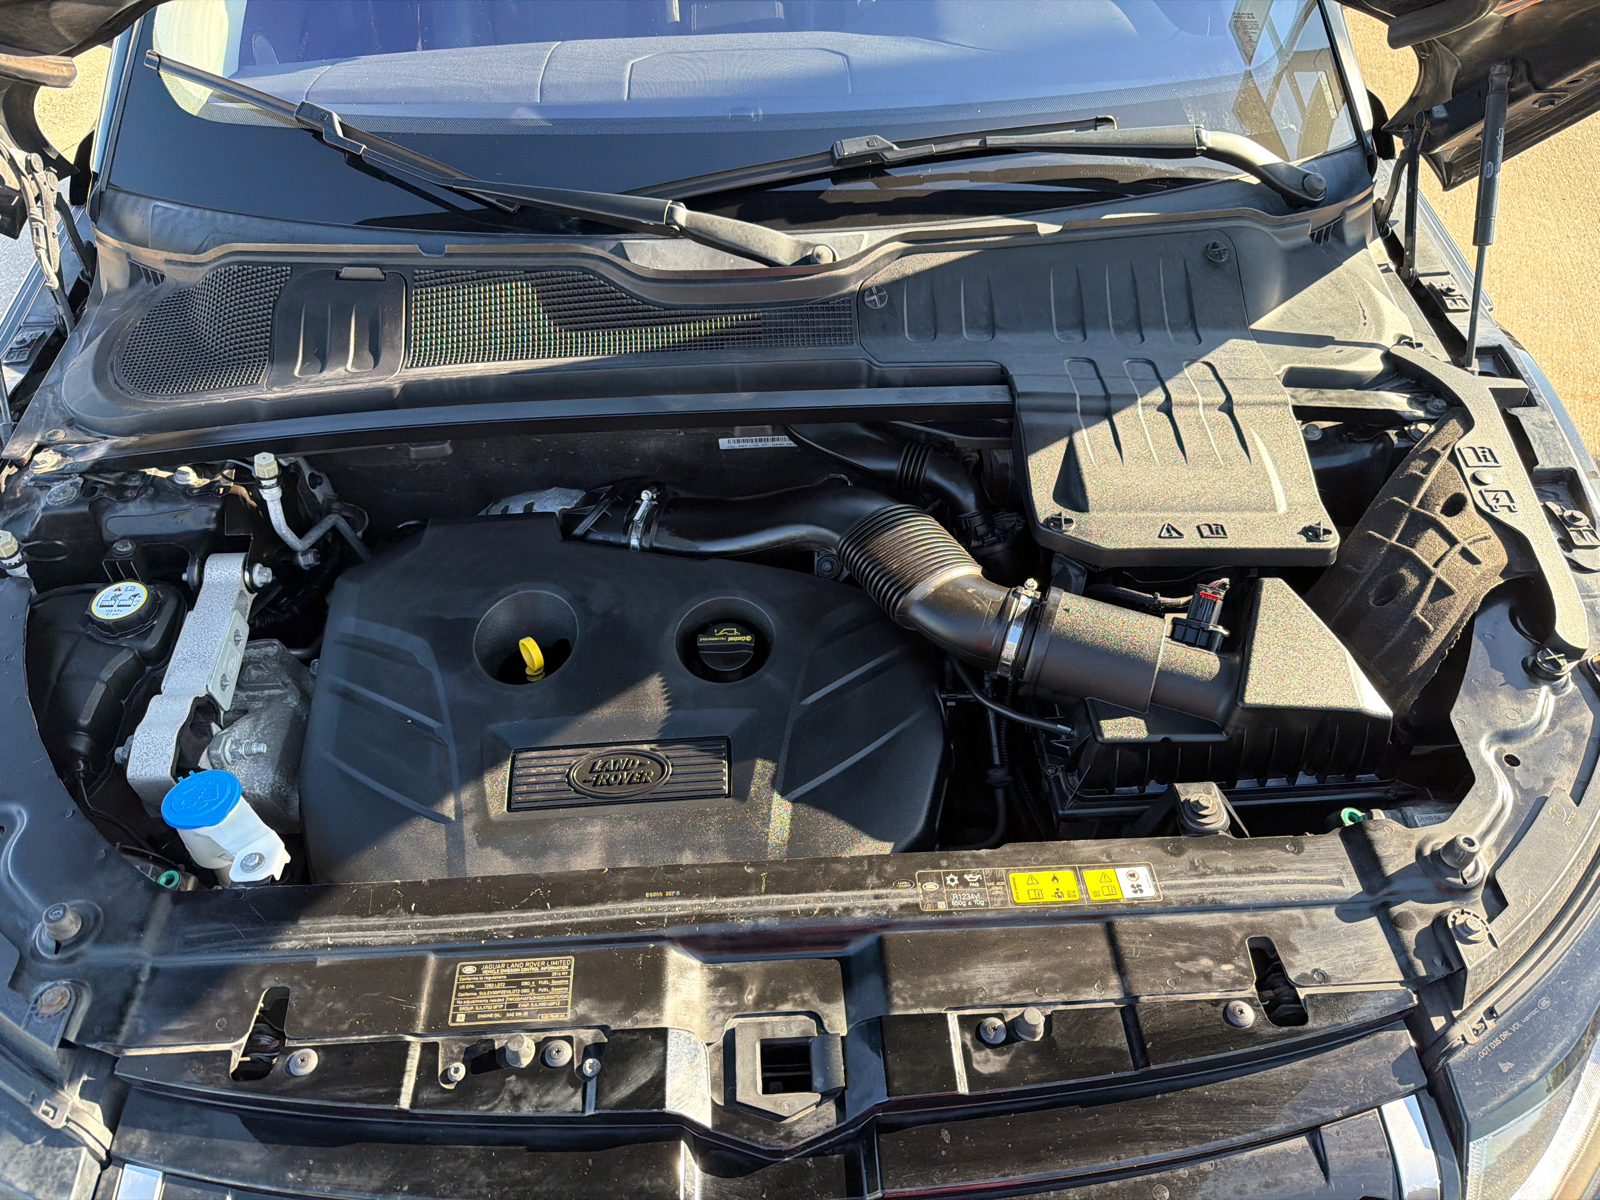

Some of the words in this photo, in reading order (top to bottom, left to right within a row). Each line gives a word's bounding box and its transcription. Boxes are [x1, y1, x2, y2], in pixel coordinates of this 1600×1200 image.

[588, 758, 640, 774] LAND
[591, 770, 655, 788] ROVER
[1478, 1046, 1491, 1058] DOT
[1500, 1030, 1512, 1041] DRL
[1510, 1022, 1522, 1032] VOL
